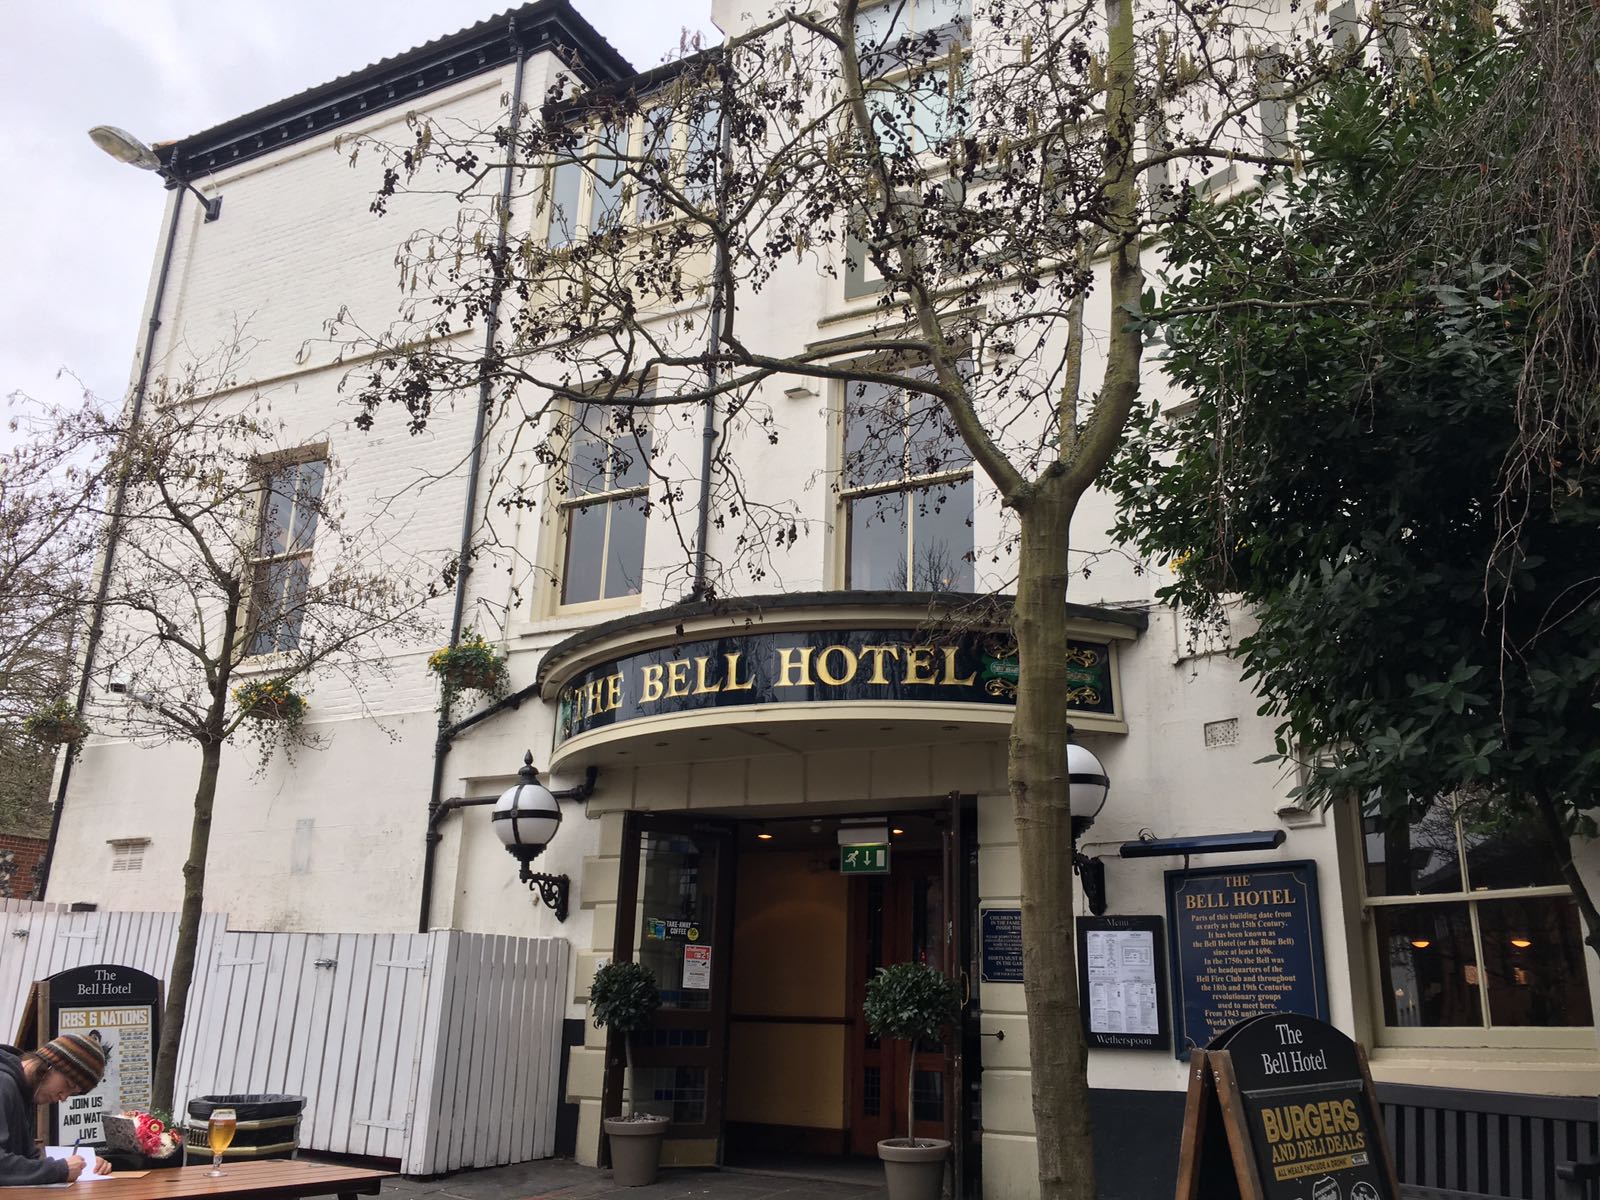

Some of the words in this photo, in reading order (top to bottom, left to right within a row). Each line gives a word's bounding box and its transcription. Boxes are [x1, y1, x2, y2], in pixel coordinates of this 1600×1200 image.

[574, 672, 624, 721] THE
[639, 652, 755, 703] BELL
[774, 644, 977, 687] HOTEL
[1224, 875, 1250, 887] THE
[1185, 893, 1229, 909] BELL
[1233, 889, 1296, 906] HOTEL
[1230, 912, 1257, 920] building
[1258, 911, 1273, 919] date
[666, 920, 691, 929] TAKE-AWAY
[1106, 918, 1129, 927] Menu
[1257, 920, 1288, 928] Century.
[1278, 938, 1295, 946] Bell)
[95, 970, 116, 981] The
[1218, 966, 1262, 974] headquarters
[1257, 974, 1296, 983] throughout
[77, 984, 99, 995] Bell
[102, 983, 132, 995] Hotel
[1258, 983, 1292, 991] Centuries
[1212, 993, 1255, 1001] revolutionary
[62, 1012, 86, 1027] RBS
[89, 1011, 97, 1026] 6
[101, 1009, 147, 1025] NATIONS
[1275, 1023, 1303, 1045] The
[1096, 1035, 1152, 1047] Wetherspoon
[1261, 1052, 1289, 1075] Bell
[1291, 1050, 1328, 1072] Hotel
[69, 1097, 90, 1110] JOIN
[91, 1096, 103, 1108] US
[63, 1114, 81, 1126] AND
[83, 1112, 102, 1124] WAT
[1261, 1099, 1360, 1143] BURGERS
[79, 1128, 97, 1140] LIVE
[1272, 1143, 1297, 1163] AND
[1298, 1139, 1327, 1160] DELI
[1327, 1132, 1365, 1155] DEALS
